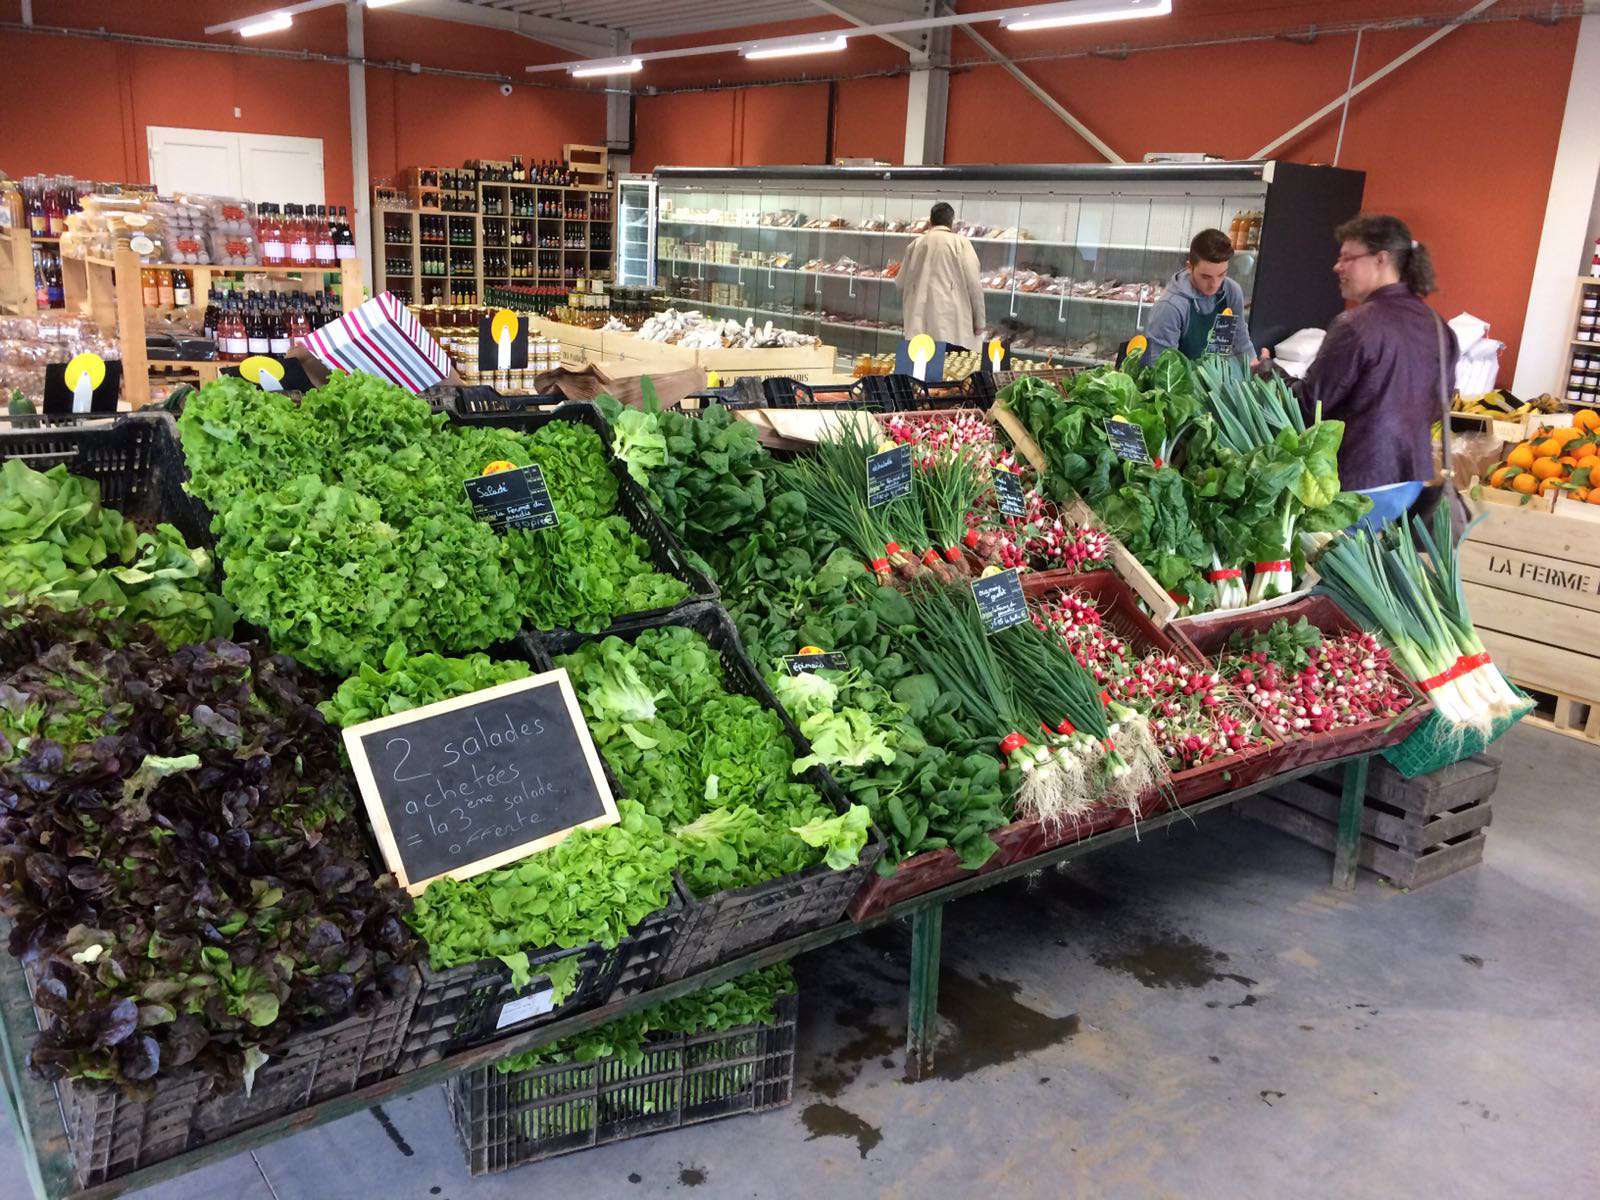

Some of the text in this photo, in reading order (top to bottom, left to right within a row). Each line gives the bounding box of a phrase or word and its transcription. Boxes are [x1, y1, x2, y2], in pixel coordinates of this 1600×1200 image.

[1489, 556, 1512, 575] LA
[1520, 562, 1591, 593] FERME
[386, 712, 545, 782] 2 salades
[405, 762, 520, 815] achetées
[428, 814, 449, 837] la
[504, 776, 560, 811] salade
[449, 812, 543, 855] offerte
